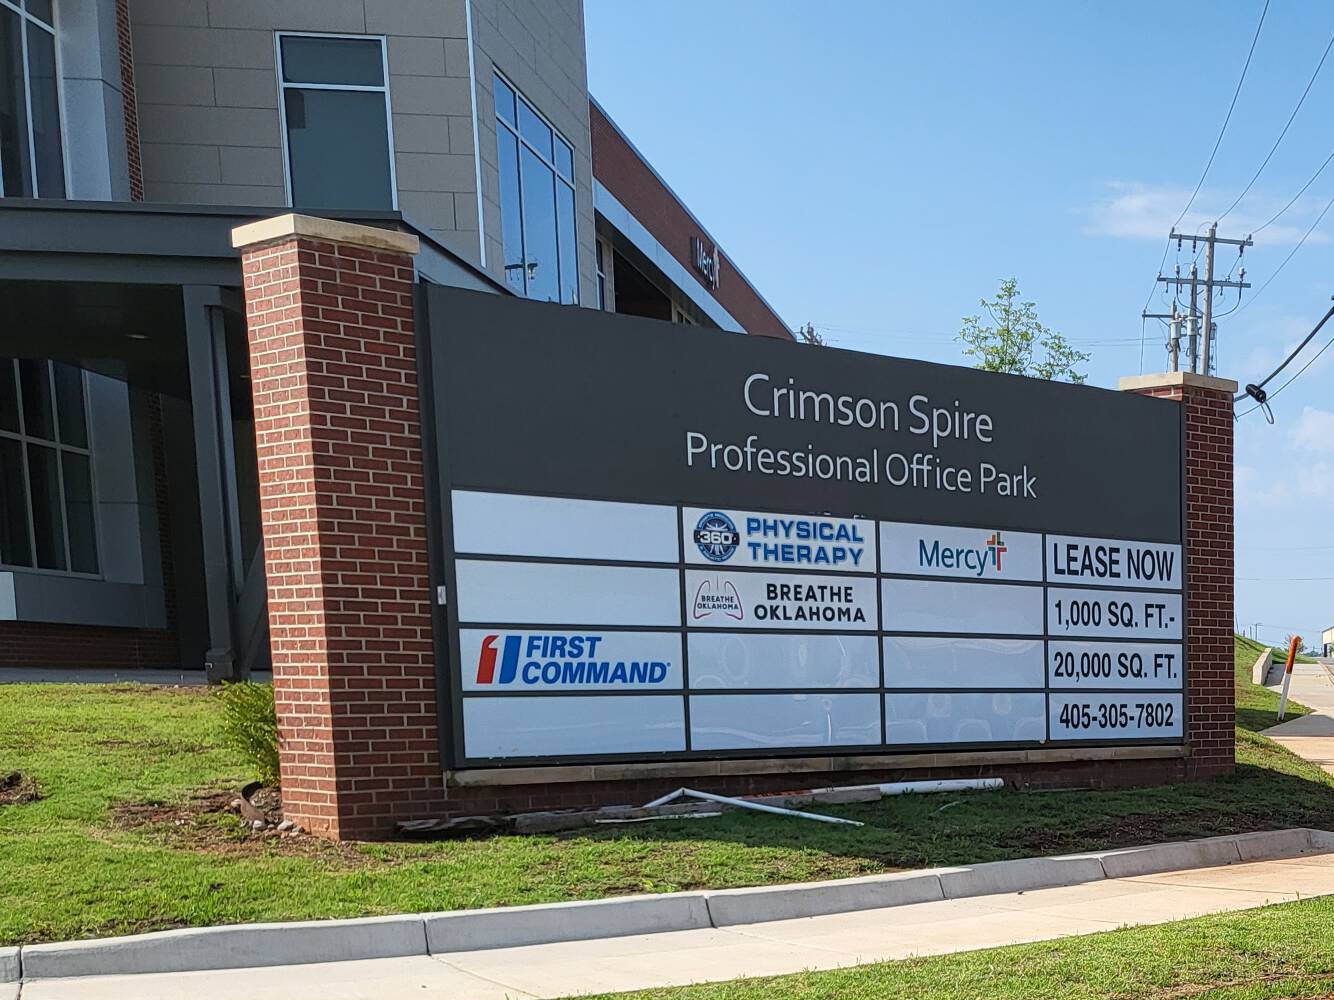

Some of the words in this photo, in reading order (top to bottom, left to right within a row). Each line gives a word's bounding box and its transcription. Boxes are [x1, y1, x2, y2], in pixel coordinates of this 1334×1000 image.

[743, 373, 899, 431] Crimson
[909, 394, 993, 448] Spire
[686, 431, 878, 483] Professional
[885, 453, 972, 492] Office
[979, 462, 1037, 499] Park
[699, 531, 733, 545] 360
[746, 517, 865, 543] PHYSICAL
[747, 542, 864, 567] THERAPY
[918, 539, 989, 577] Mercy
[1053, 543, 1121, 579] LEASE
[1127, 548, 1175, 582] NOW
[697, 602, 740, 610] OKLAHOMA
[701, 595, 735, 603] BREATHE
[766, 583, 854, 604] BREATHE
[753, 604, 867, 623] OKLAHOMA
[1054, 600, 1102, 631] 1,000
[1107, 601, 1139, 628] SQ.
[1144, 603, 1175, 628] FT.-
[525, 635, 603, 659] FIRST
[521, 661, 668, 685] COMMAND
[1053, 652, 1112, 682] 20,000
[1117, 653, 1148, 678] SQ.
[1154, 653, 1177, 679] FT.
[1059, 702, 1174, 729] 405-305-7802
